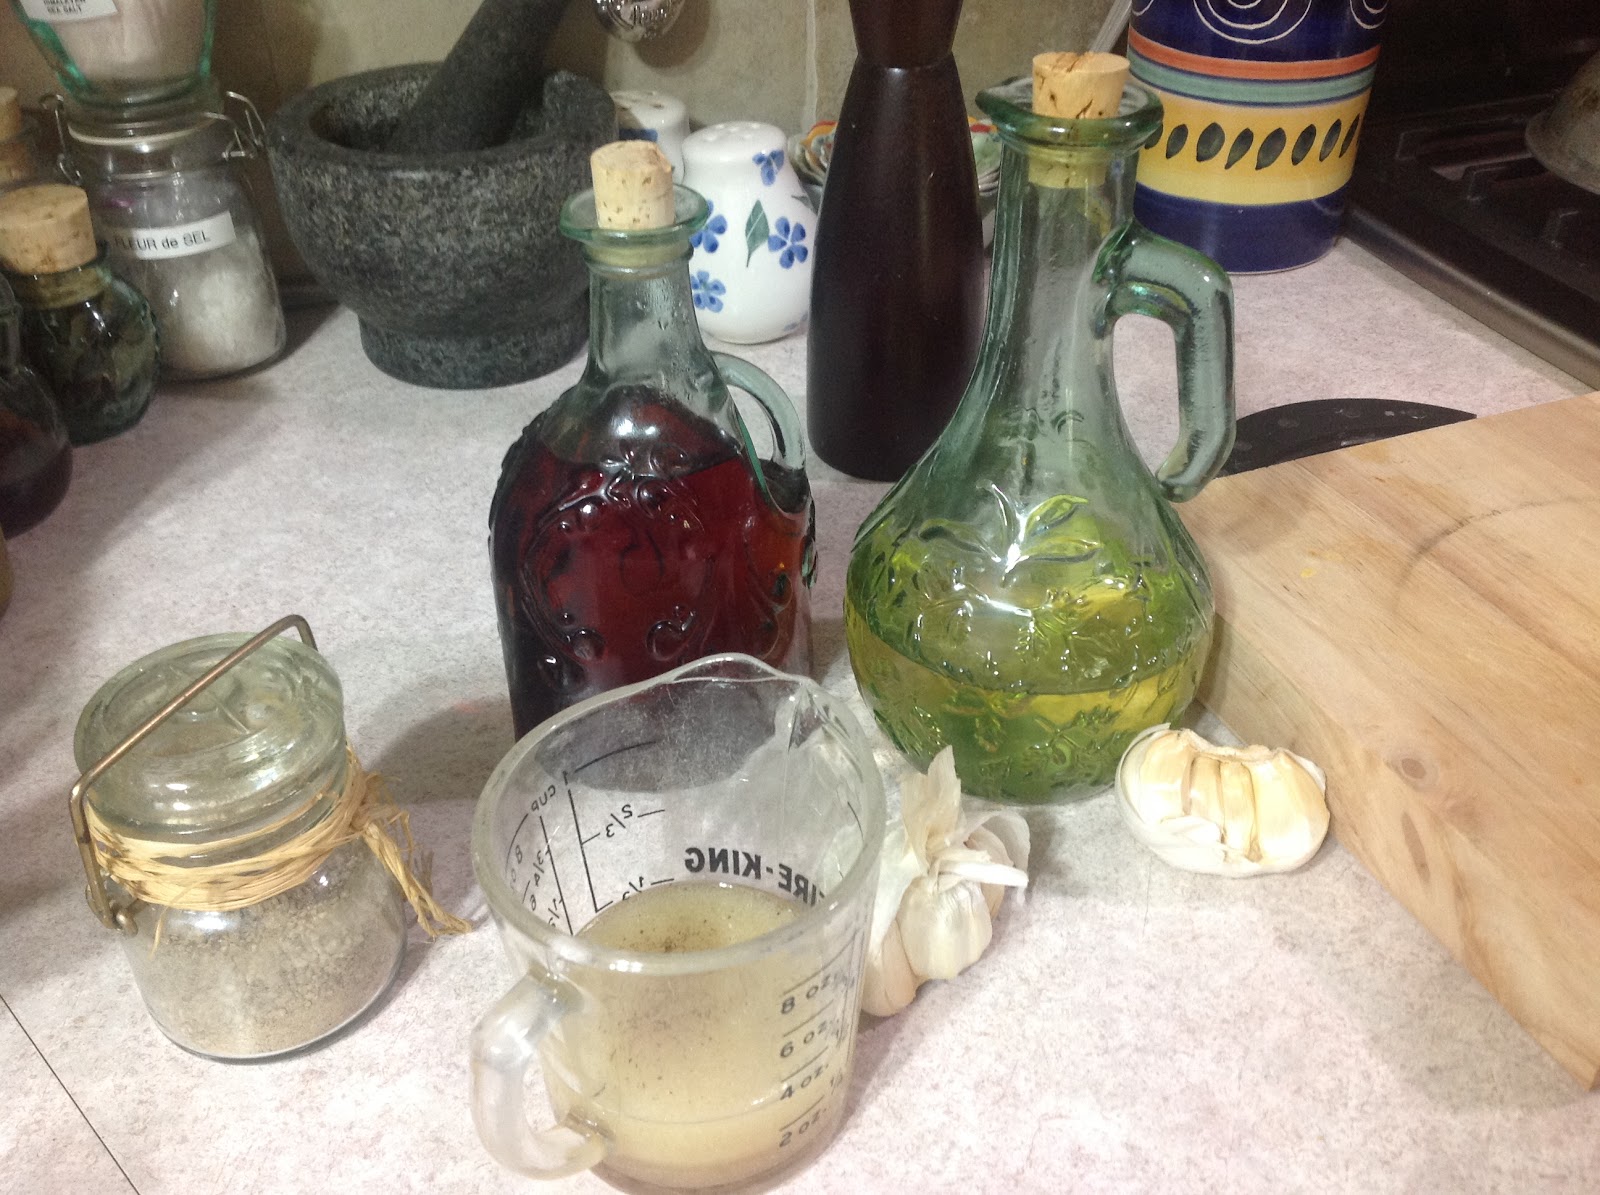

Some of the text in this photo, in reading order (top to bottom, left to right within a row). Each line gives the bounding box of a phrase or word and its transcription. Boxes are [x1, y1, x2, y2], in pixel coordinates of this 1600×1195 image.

[113, 236, 158, 251] FLEUR
[161, 236, 179, 250] de
[781, 995, 796, 1015] 8
[780, 1040, 794, 1059] 6
[779, 1085, 794, 1101] 4
[779, 1131, 792, 1148] 2
